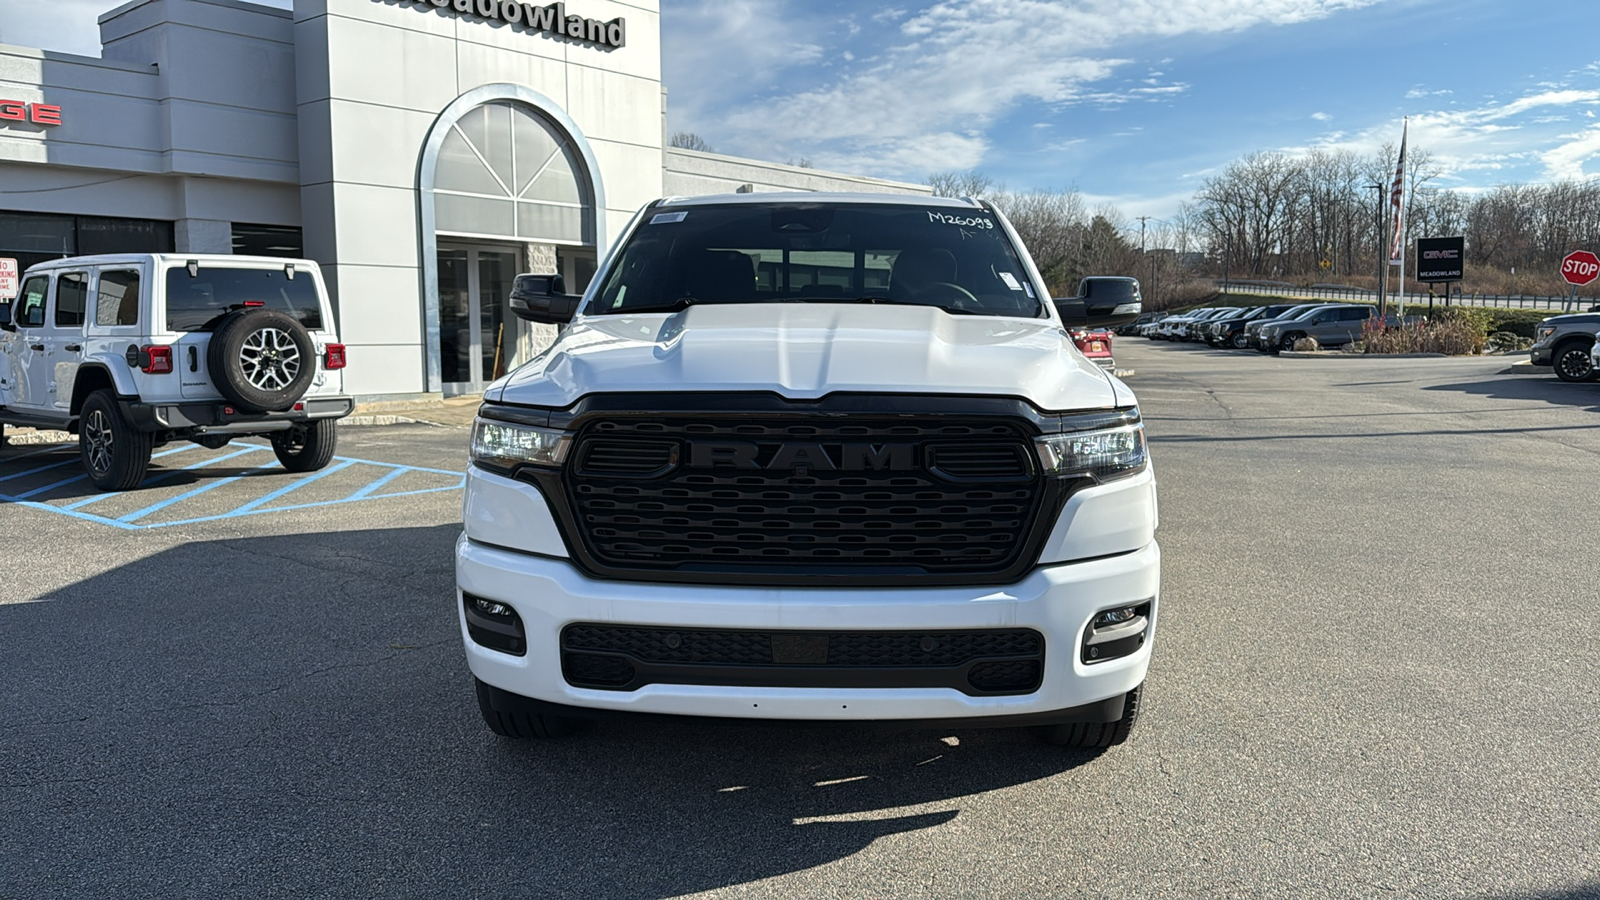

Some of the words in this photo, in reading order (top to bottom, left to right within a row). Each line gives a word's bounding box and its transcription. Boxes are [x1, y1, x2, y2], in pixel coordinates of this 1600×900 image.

[417, 0, 625, 48] adowland
[1423, 249, 1459, 260] GMC
[1563, 259, 1598, 276] STOP
[690, 440, 914, 471] RAM
